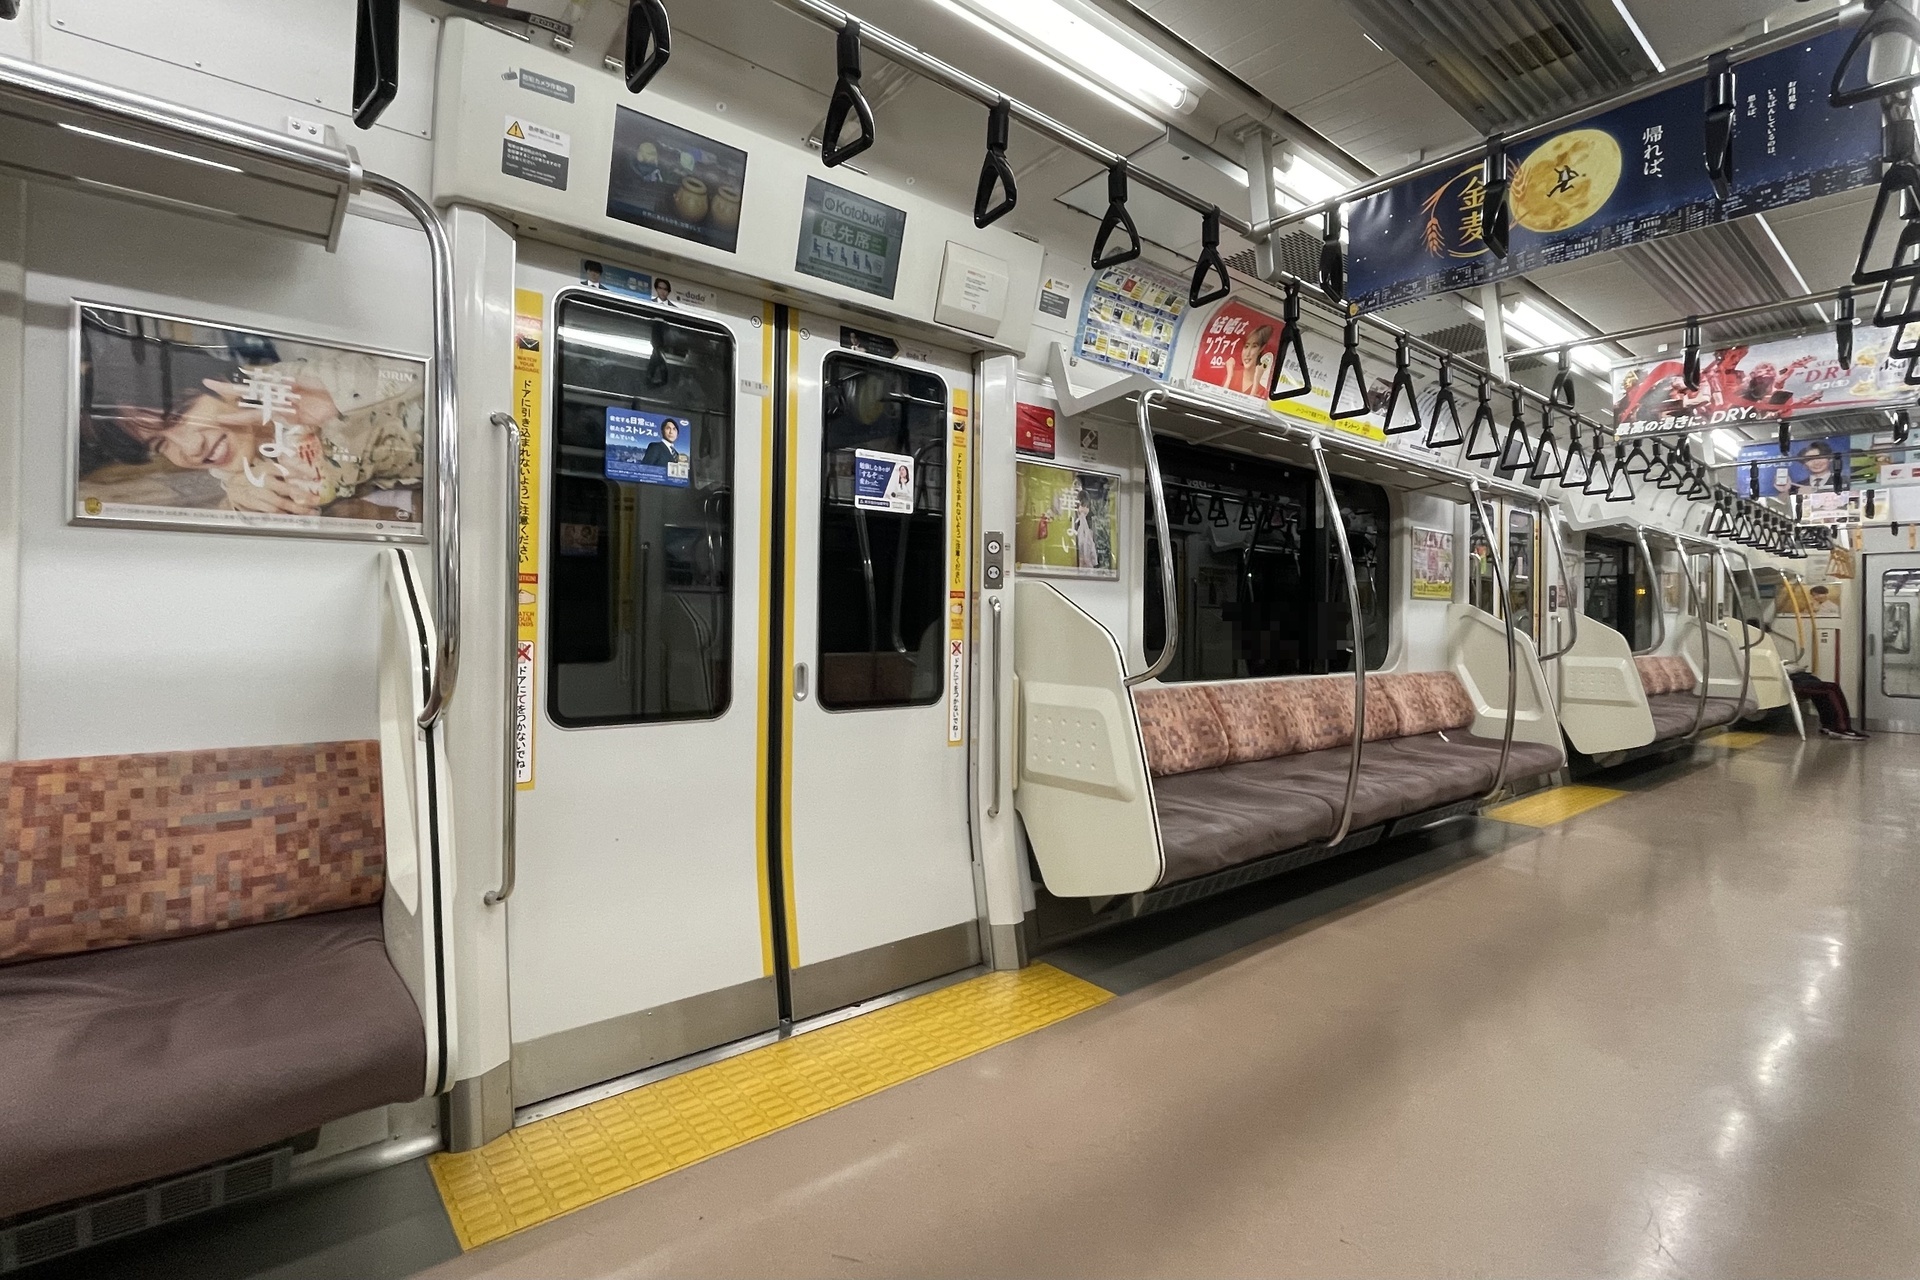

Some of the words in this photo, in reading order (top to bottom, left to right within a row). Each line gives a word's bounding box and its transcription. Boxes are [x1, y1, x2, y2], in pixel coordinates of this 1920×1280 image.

[1642, 124, 1665, 178] 帰れば、
[835, 201, 887, 229] Kotobuki
[821, 218, 872, 251] 優先席
[1204, 335, 1241, 355] ツヴァイ
[378, 368, 414, 383] KIRIN
[238, 366, 301, 489] 華よい
